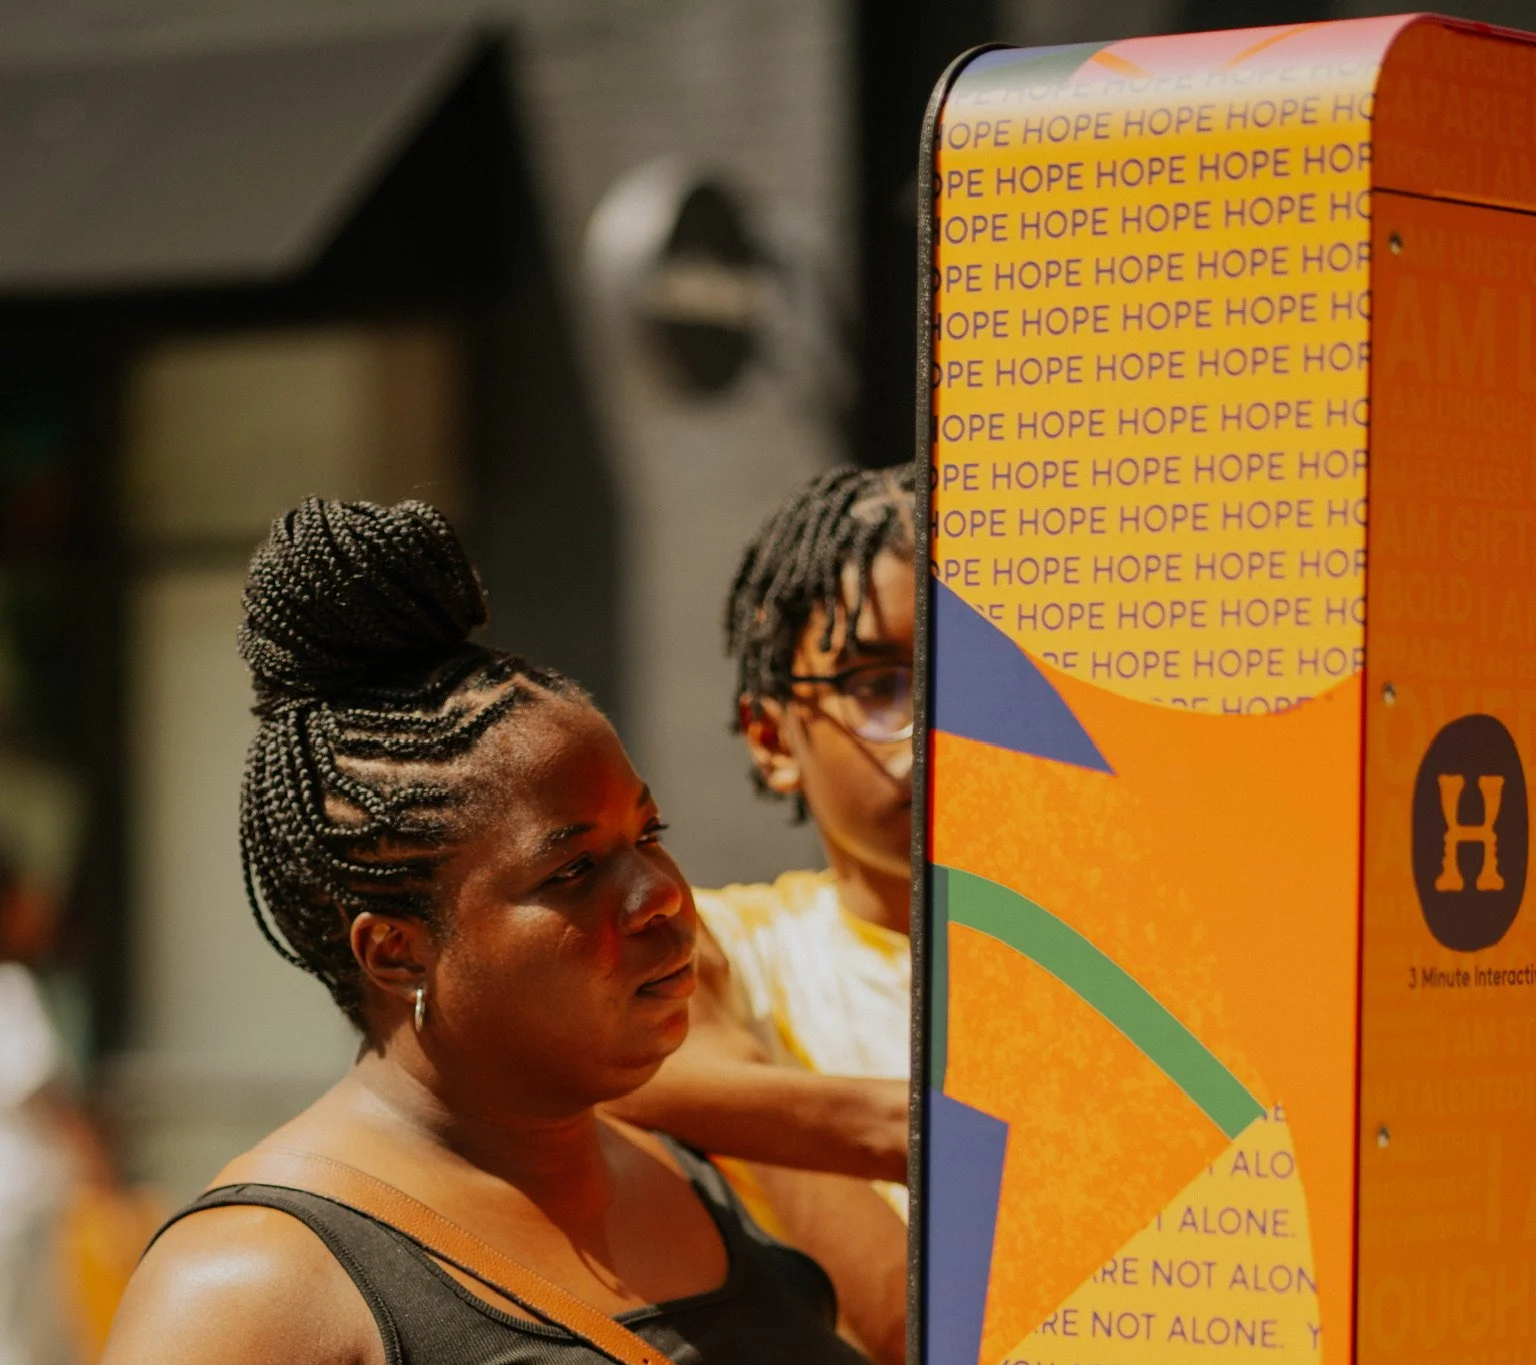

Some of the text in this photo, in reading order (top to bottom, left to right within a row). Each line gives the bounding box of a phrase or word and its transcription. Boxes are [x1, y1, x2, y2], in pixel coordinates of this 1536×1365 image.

[1023, 112, 1111, 145] HOPE
[1124, 105, 1212, 137] HOPE
[1227, 98, 1317, 130] HOPE
[996, 162, 1084, 196] HOPE
[1097, 155, 1186, 188] HOPE
[1200, 148, 1290, 181] HOPE
[1021, 207, 1108, 240] HOPE
[1122, 201, 1211, 234] HOPE
[1225, 193, 1316, 227] HOPE
[995, 259, 1082, 290] HOPE
[1095, 253, 1184, 284] HOPE
[1198, 246, 1289, 279] HOPE
[1022, 305, 1110, 336] HOPE
[1123, 299, 1212, 331] HOPE
[1226, 293, 1317, 325] HOPE
[996, 356, 1083, 386] HOPE
[1096, 351, 1185, 381] HOPE
[1199, 346, 1289, 377] HOPE
[1018, 409, 1105, 439] HOPE
[1119, 405, 1208, 435] HOPE
[1222, 400, 1312, 431] HOPE
[992, 460, 1079, 490] HOPE
[1093, 456, 1181, 486] HOPE
[1195, 452, 1284, 482] HOPE
[1019, 507, 1106, 535] HOPE
[1120, 503, 1209, 532] HOPE
[1223, 500, 1313, 529] HOPE
[931, 558, 980, 586] PE
[993, 556, 1080, 585] HOPE
[1094, 554, 1182, 583] HOPE
[1196, 551, 1285, 580] HOPE
[1018, 602, 1105, 631] HOPE
[1119, 600, 1206, 629] HOPE
[1221, 598, 1311, 627] HOPE
[1092, 650, 1180, 679] HOPE
[1194, 649, 1284, 677] HOPE
[1434, 774, 1505, 891] H
[1408, 963, 1536, 989] 3 Minute Interacti
[1179, 1206, 1296, 1238] ALONE.
[1093, 1258, 1139, 1286] RE
[1153, 1260, 1216, 1289] NOT
[1035, 1309, 1078, 1337] RE
[1092, 1311, 1156, 1340] NOT
[1168, 1316, 1284, 1350] ALONE.
